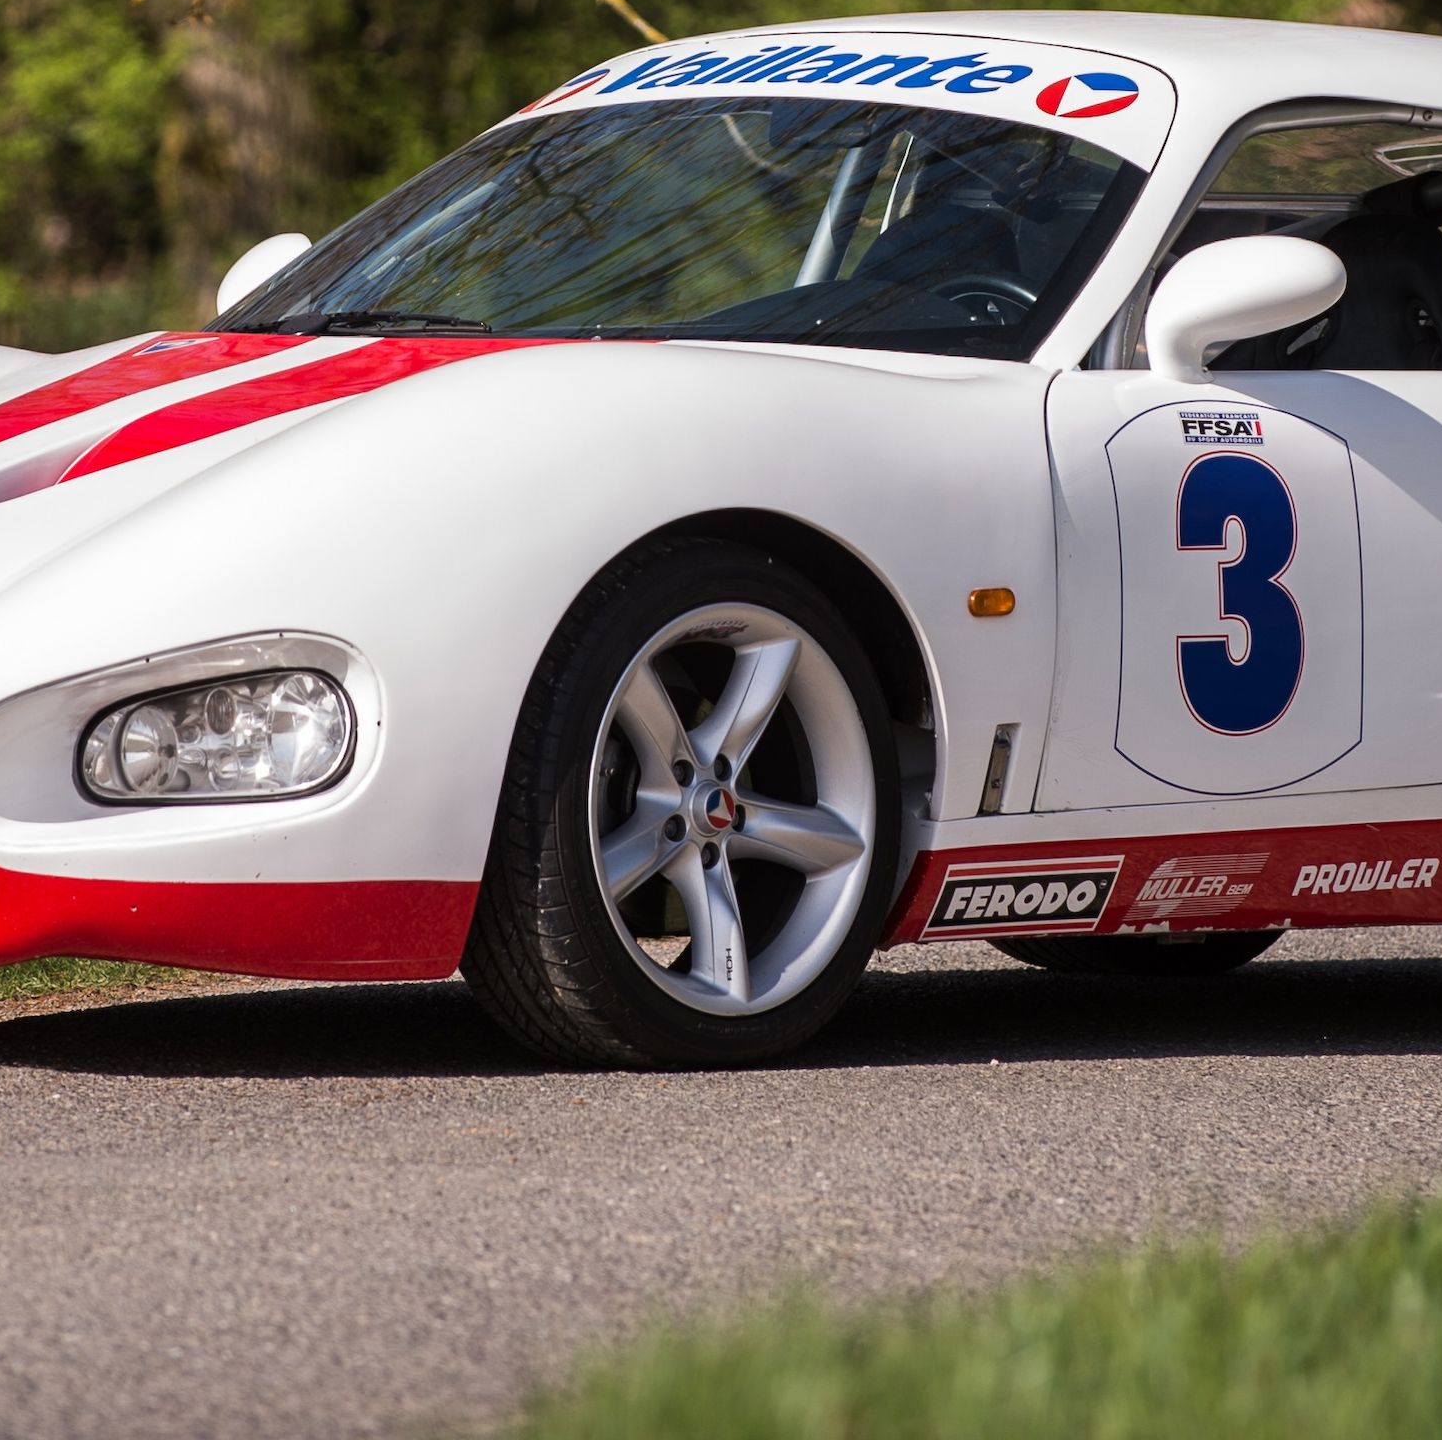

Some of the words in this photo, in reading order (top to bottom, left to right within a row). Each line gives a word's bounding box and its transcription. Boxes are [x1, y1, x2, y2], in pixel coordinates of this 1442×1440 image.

[594, 45, 1034, 95] Vaillante
[1181, 419, 1253, 436] FFSA
[1176, 450, 1306, 737] 3
[1135, 875, 1228, 902] MULLER
[1225, 883, 1254, 897] BEM
[1291, 857, 1440, 896] PROWLER
[943, 879, 1098, 921] FERODO
[725, 947, 733, 981] ROH
